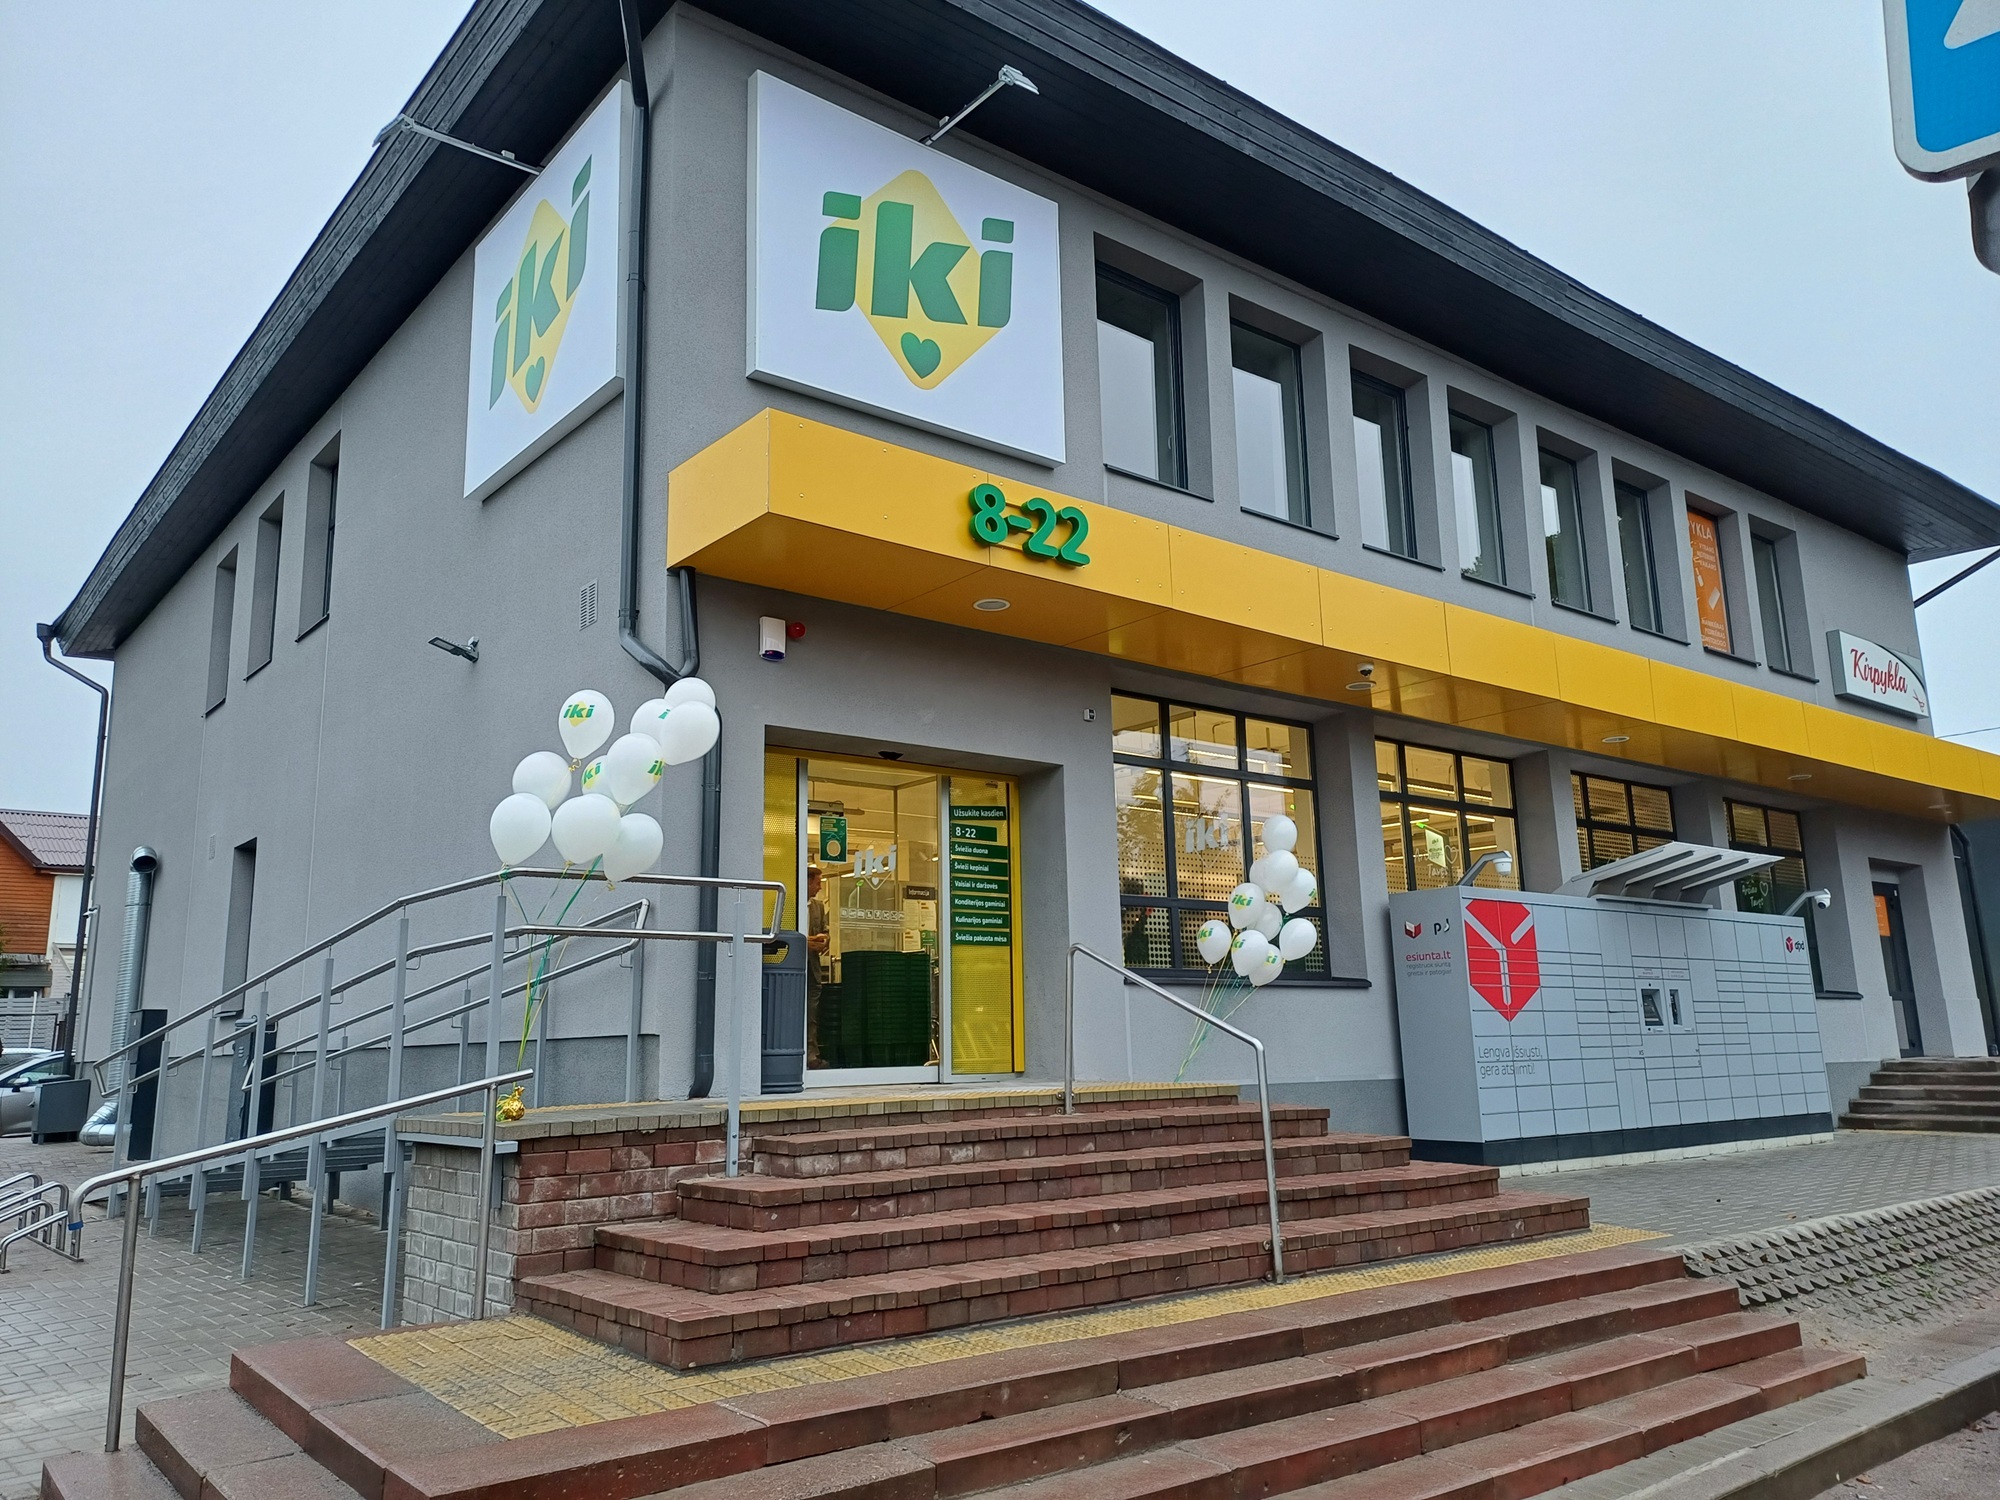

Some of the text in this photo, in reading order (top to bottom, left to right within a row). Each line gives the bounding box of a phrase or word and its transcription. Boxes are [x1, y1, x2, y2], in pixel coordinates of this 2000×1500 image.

[815, 191, 1014, 328] iki
[489, 154, 592, 411] iki
[968, 483, 1091, 567] 8-22
[1850, 648, 1907, 694] Kirpykla
[563, 704, 595, 719] iki
[583, 762, 602, 785] ki
[647, 760, 664, 776] ik
[953, 808, 1004, 817] Užsukite kasdien
[955, 826, 977, 838] 8-22
[1185, 813, 1229, 853] iki
[854, 844, 897, 878] iki
[954, 880, 971, 888] Vaisiai
[954, 898, 1006, 908] Konditerijos gaminiai
[1231, 894, 1254, 907] iki
[955, 916, 1003, 925] Kulinarijos gaminiai
[1233, 939, 1246, 949] ki
[1405, 951, 1451, 962] esiunta.lt
[1478, 1046, 1510, 1060] Lengva
[1480, 1065, 1500, 1079] gera
